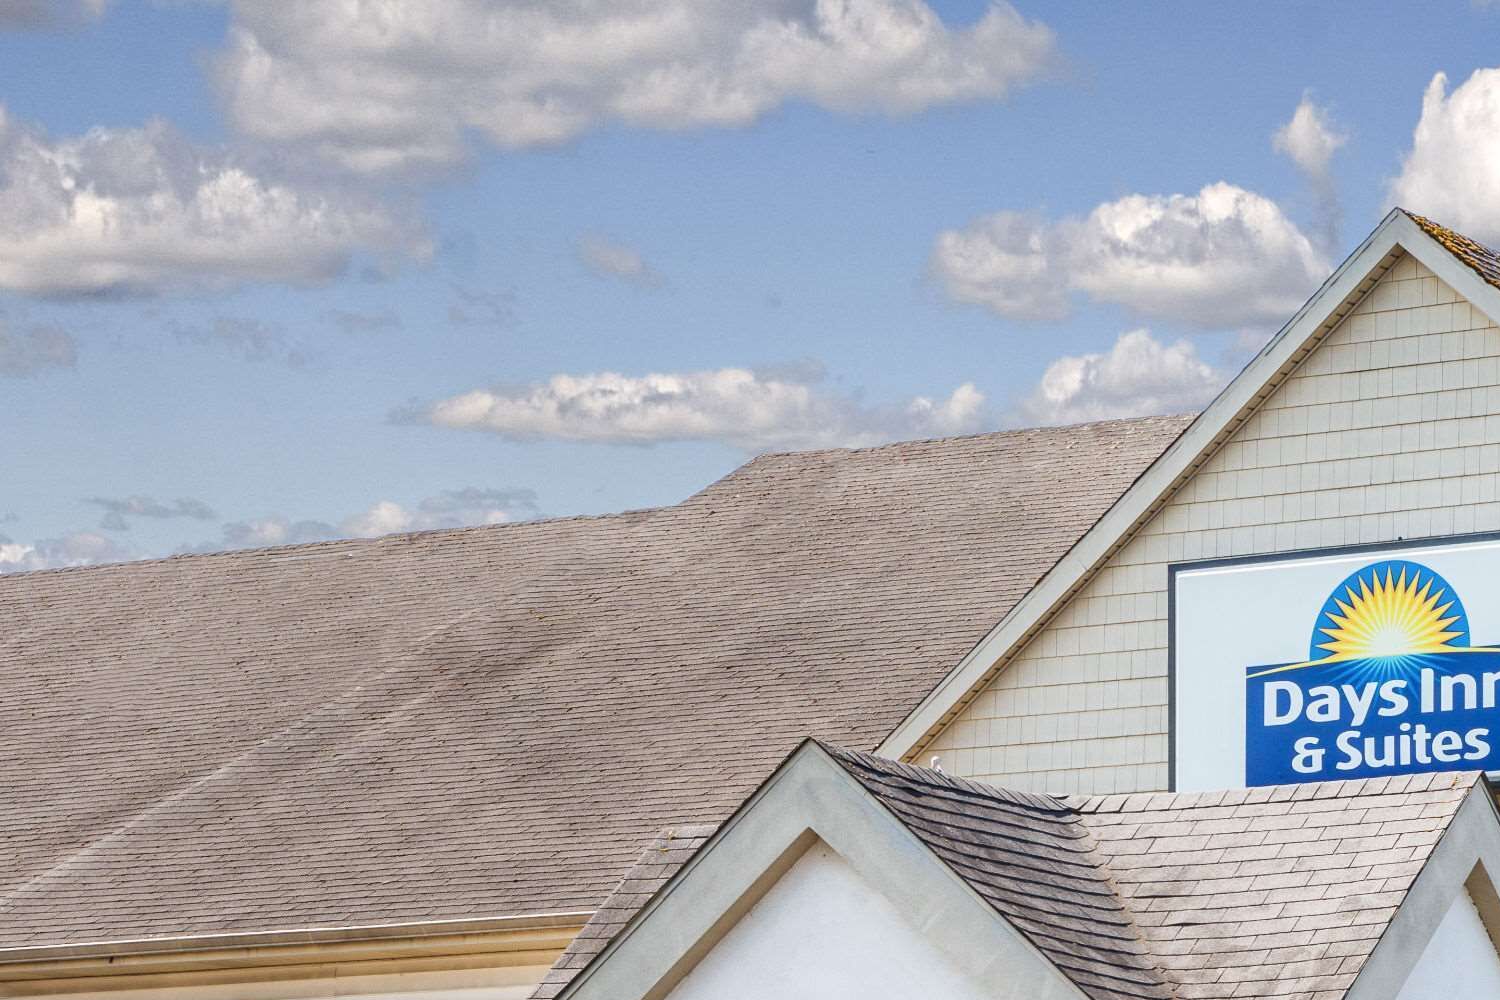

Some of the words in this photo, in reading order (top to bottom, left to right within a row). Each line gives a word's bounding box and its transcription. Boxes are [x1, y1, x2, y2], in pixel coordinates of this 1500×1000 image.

[1264, 679, 1409, 727] Days
[1291, 736, 1326, 774] &
[1335, 722, 1491, 771] Suites
